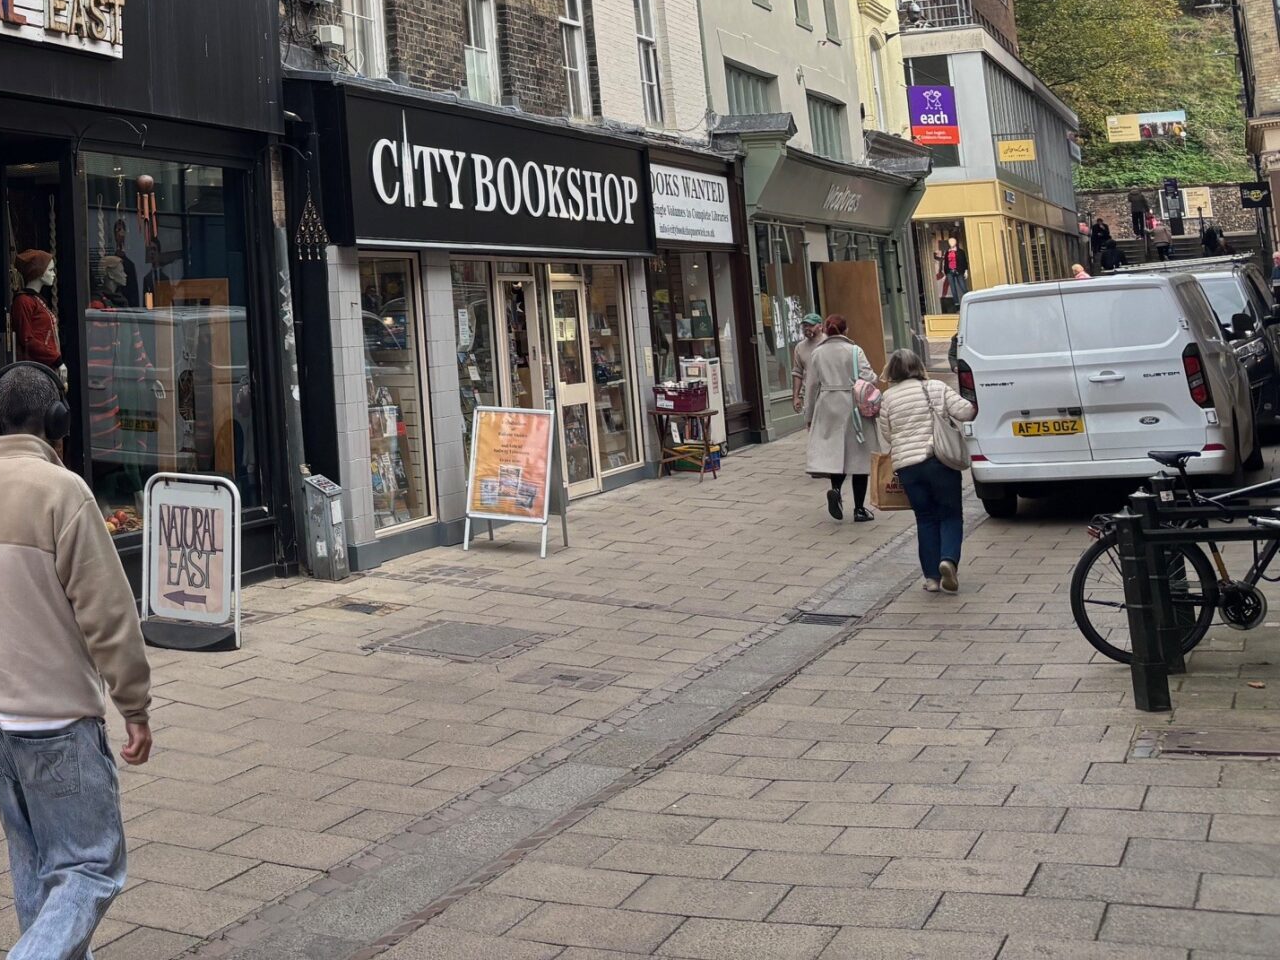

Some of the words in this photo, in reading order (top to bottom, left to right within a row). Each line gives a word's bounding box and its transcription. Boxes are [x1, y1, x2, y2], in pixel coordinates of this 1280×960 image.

[920, 111, 949, 124] each
[372, 110, 466, 209] CITY
[471, 153, 638, 224] BOOKSHOP
[681, 175, 724, 203] WANTED
[667, 205, 686, 218] Volumes
[692, 208, 711, 222] Complete
[712, 210, 729, 222] Libraries
[1018, 421, 1049, 434] AF75
[1053, 420, 1079, 432] OGZ
[159, 503, 223, 552] NATURAL
[167, 548, 216, 589] EAST
